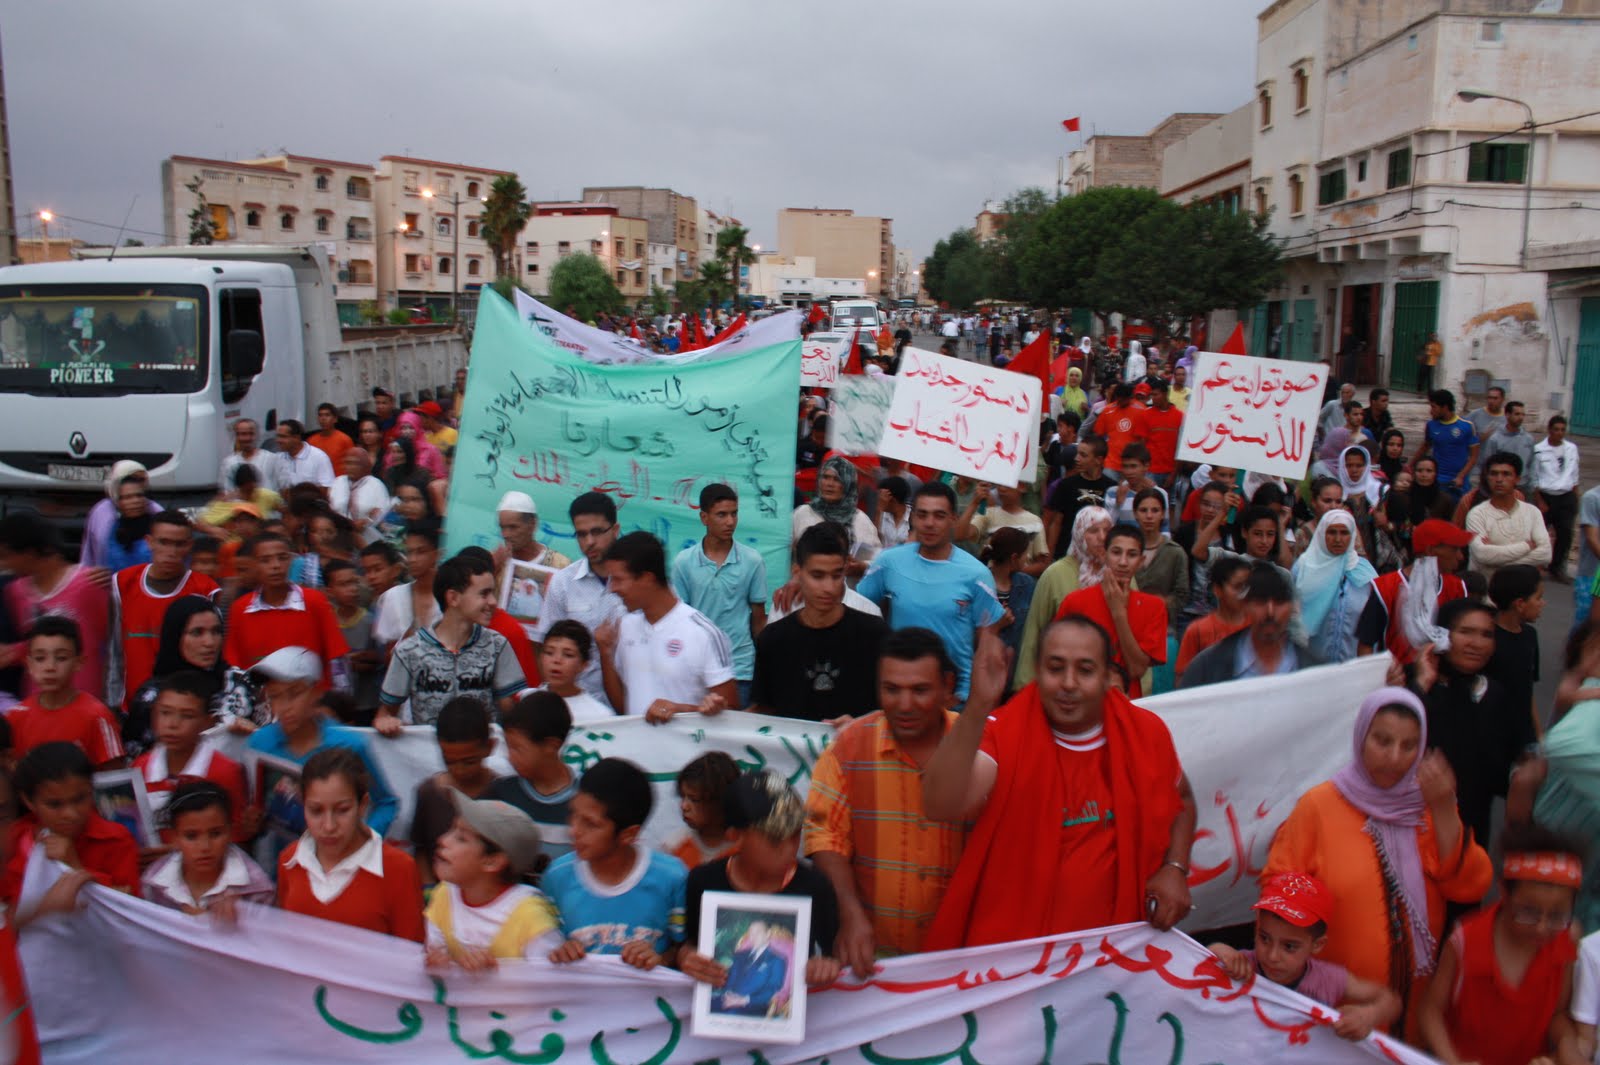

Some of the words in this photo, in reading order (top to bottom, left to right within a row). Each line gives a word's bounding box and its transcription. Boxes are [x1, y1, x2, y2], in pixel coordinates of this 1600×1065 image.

[801, 345, 832, 361] نع
[50, 367, 115, 384] PIONEER
[1252, 364, 1320, 410] صوتوا
[951, 377, 1031, 414] دستور
[888, 399, 969, 445] الشباب
